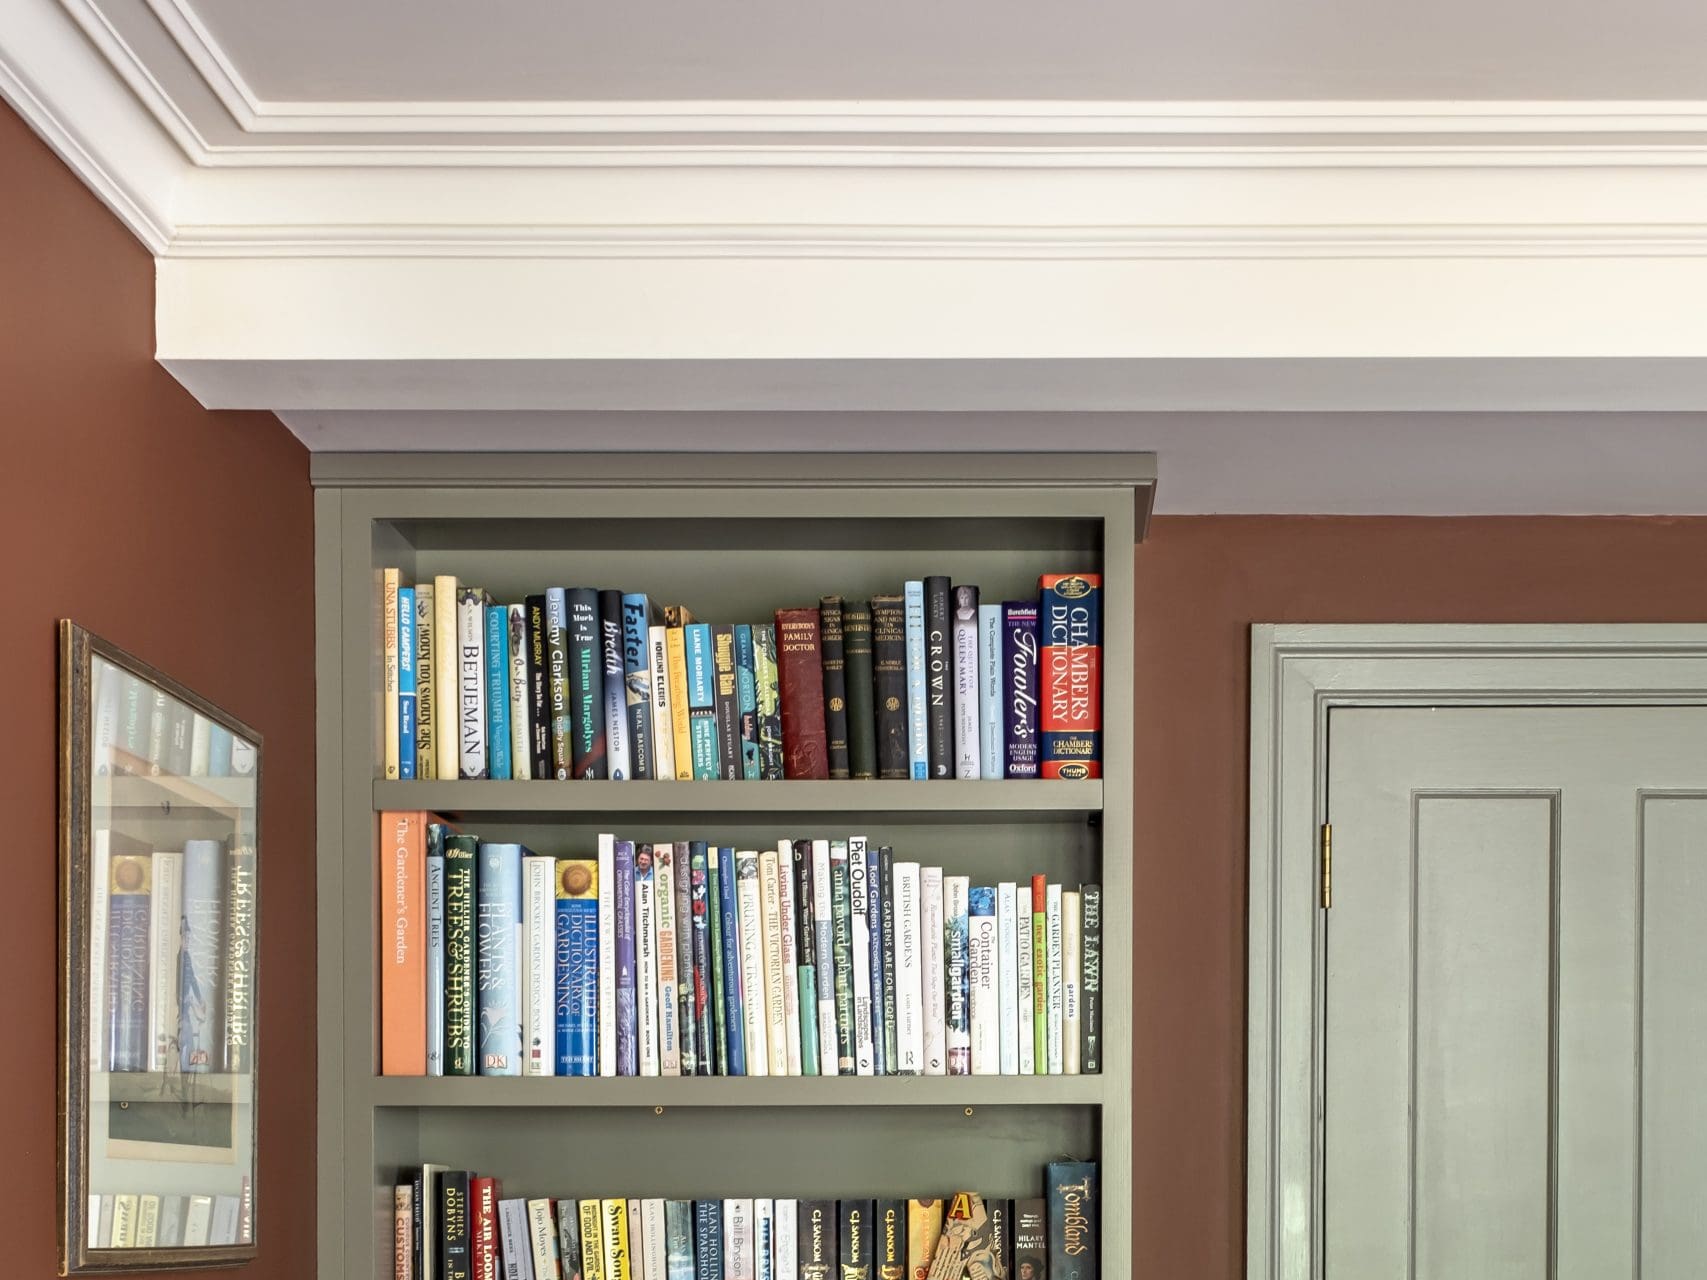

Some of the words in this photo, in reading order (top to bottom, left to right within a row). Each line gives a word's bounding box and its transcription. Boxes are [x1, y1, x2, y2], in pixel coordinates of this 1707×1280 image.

[402, 597, 410, 624] HELLO
[532, 606, 540, 629] ANDY
[549, 596, 561, 644] Jeremy
[402, 627, 410, 671] CAMPERS!
[489, 612, 500, 668] COURTING
[533, 631, 542, 665] MURRAY
[624, 603, 644, 666] Faster
[693, 629, 701, 654] LIANE
[958, 629, 966, 659] QUEEN
[419, 662, 430, 684] You
[553, 650, 564, 710] Clarkson
[581, 648, 591, 690] Miriam
[695, 657, 704, 702] MORIARTY
[930, 630, 943, 706] CROWN
[959, 662, 967, 695] MARY
[1051, 605, 1068, 723] DICTIONARY
[1070, 607, 1088, 720] CHAMBERS
[463, 646, 480, 755] BETJEMAN
[493, 673, 503, 723] TRIUMPH
[741, 668, 751, 710] NORTON
[1013, 629, 1036, 738] Fowler's
[419, 688, 430, 725] Knows
[583, 694, 593, 753] Margolyes
[419, 729, 431, 750] She
[637, 733, 645, 771] BASCOMB
[396, 818, 408, 843] The
[765, 857, 776, 876] Tom
[851, 840, 865, 866] Piet
[396, 847, 408, 914] Gardener's
[431, 864, 440, 910] ANCIENT
[641, 883, 650, 905] Alan
[767, 878, 777, 904] Carter
[779, 864, 789, 897] Living
[834, 870, 844, 902] anna
[852, 869, 865, 915] Oudolf
[902, 876, 911, 917] BRITISH
[447, 869, 463, 940] TREES
[657, 873, 672, 928] organic
[781, 899, 791, 932] Under
[396, 918, 408, 963] Garden
[432, 916, 441, 947] TREES
[491, 903, 506, 973] PLANTS
[642, 908, 651, 957] Titchmarsh
[768, 911, 779, 932] THE
[832, 905, 847, 946] pavord
[449, 942, 463, 960] &
[479, 903, 491, 991] FLOWERS
[660, 930, 674, 982] GARDENING
[769, 934, 780, 985] VICTORIAN
[783, 935, 793, 964] Glass
[903, 920, 913, 968] GARDENS
[980, 921, 992, 989] Container
[492, 978, 506, 990] &
[558, 914, 569, 1016] GARDENING
[584, 914, 597, 1017] ILLUSTRATED
[835, 955, 848, 987] plant
[448, 963, 463, 1048] SHRUBS
[664, 986, 673, 1010] Geoff
[771, 987, 782, 1026] GARDEN
[1067, 984, 1075, 1018] gardens
[664, 1012, 674, 1051] Hamilton
[837, 992, 851, 1045] partners
[447, 1188, 455, 1241] DOBYNS
[456, 1191, 464, 1236] STEPHEN
[482, 1186, 491, 1213] THE
[534, 1207, 546, 1226] Jojo
[699, 1203, 707, 1224] THE
[708, 1203, 717, 1234] ALAN
[812, 1209, 821, 1223] C.J.
[850, 1210, 859, 1224] C.J.
[885, 1209, 894, 1223] C.J.
[1056, 1176, 1092, 1255] Tombland
[483, 1217, 492, 1241] AIR
[536, 1227, 547, 1257] Moyes
[608, 1205, 622, 1246] Swan
[733, 1216, 744, 1234] Bill
[813, 1224, 821, 1262] SANSOM
[851, 1226, 859, 1263] SANSOM
[886, 1225, 894, 1262] SANSOM
[396, 1217, 404, 1280] CUSTOMS
[733, 1238, 744, 1278] Bryson
